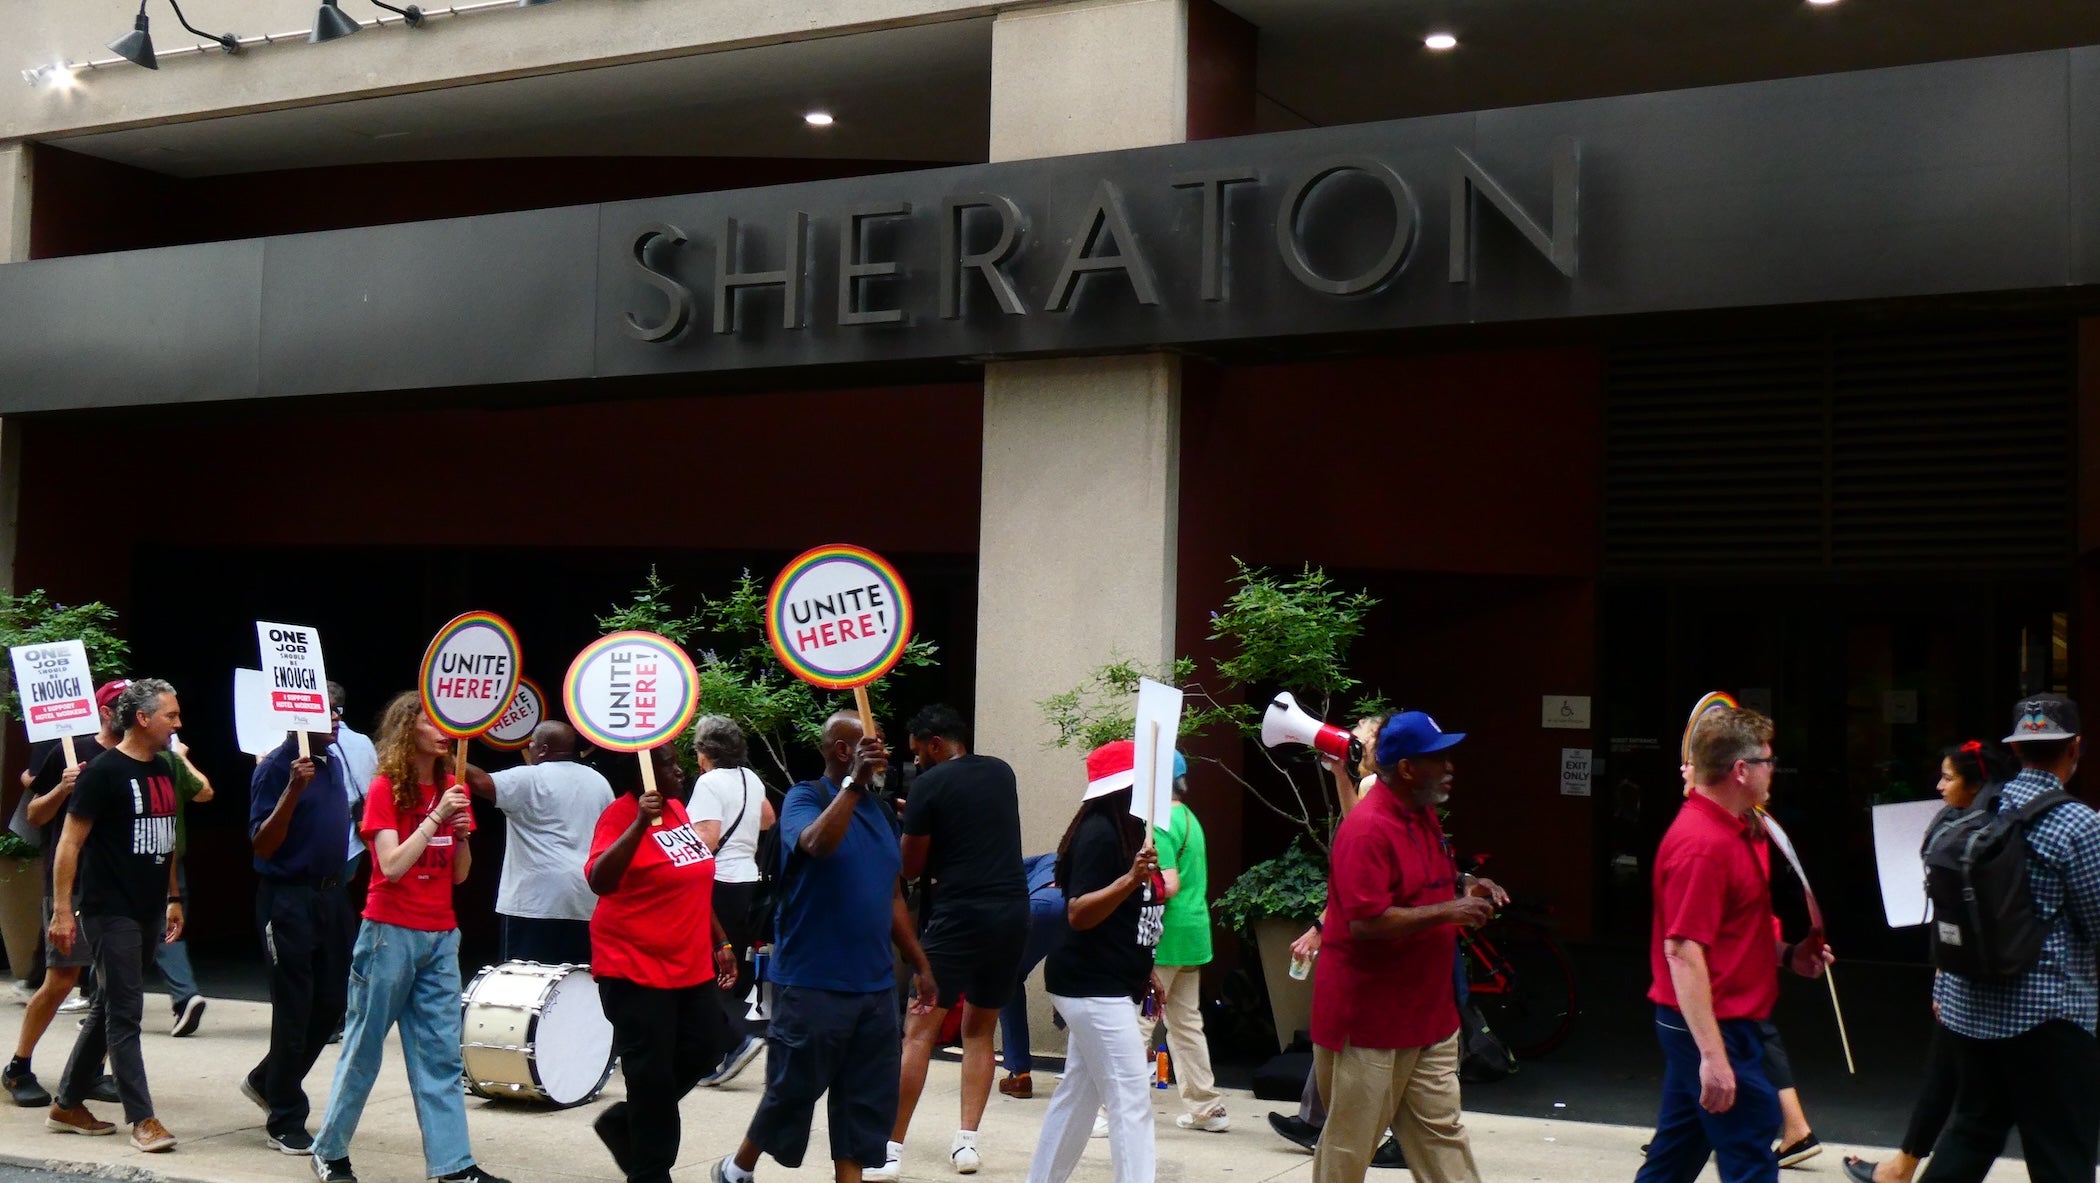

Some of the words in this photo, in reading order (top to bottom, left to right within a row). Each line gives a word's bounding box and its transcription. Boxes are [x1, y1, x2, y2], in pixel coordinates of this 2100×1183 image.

[622, 137, 1580, 343] SHERATON
[790, 584, 884, 624] UNITE
[269, 629, 308, 645] ONE
[796, 610, 887, 652] HERE!
[25, 646, 71, 661] ONE
[276, 644, 307, 653] JOB
[33, 658, 70, 669] JOB
[441, 653, 507, 676] UNITE
[31, 677, 82, 702] ENOUGH
[273, 666, 317, 690] ENOUGH
[436, 677, 502, 700] HERE!
[609, 652, 632, 729] UNITE
[635, 654, 658, 729] HERE!
[493, 703, 535, 732] HERE!
[1563, 771, 1590, 781] ONLY
[1565, 761, 1588, 770] EXIT
[130, 778, 144, 814] I
